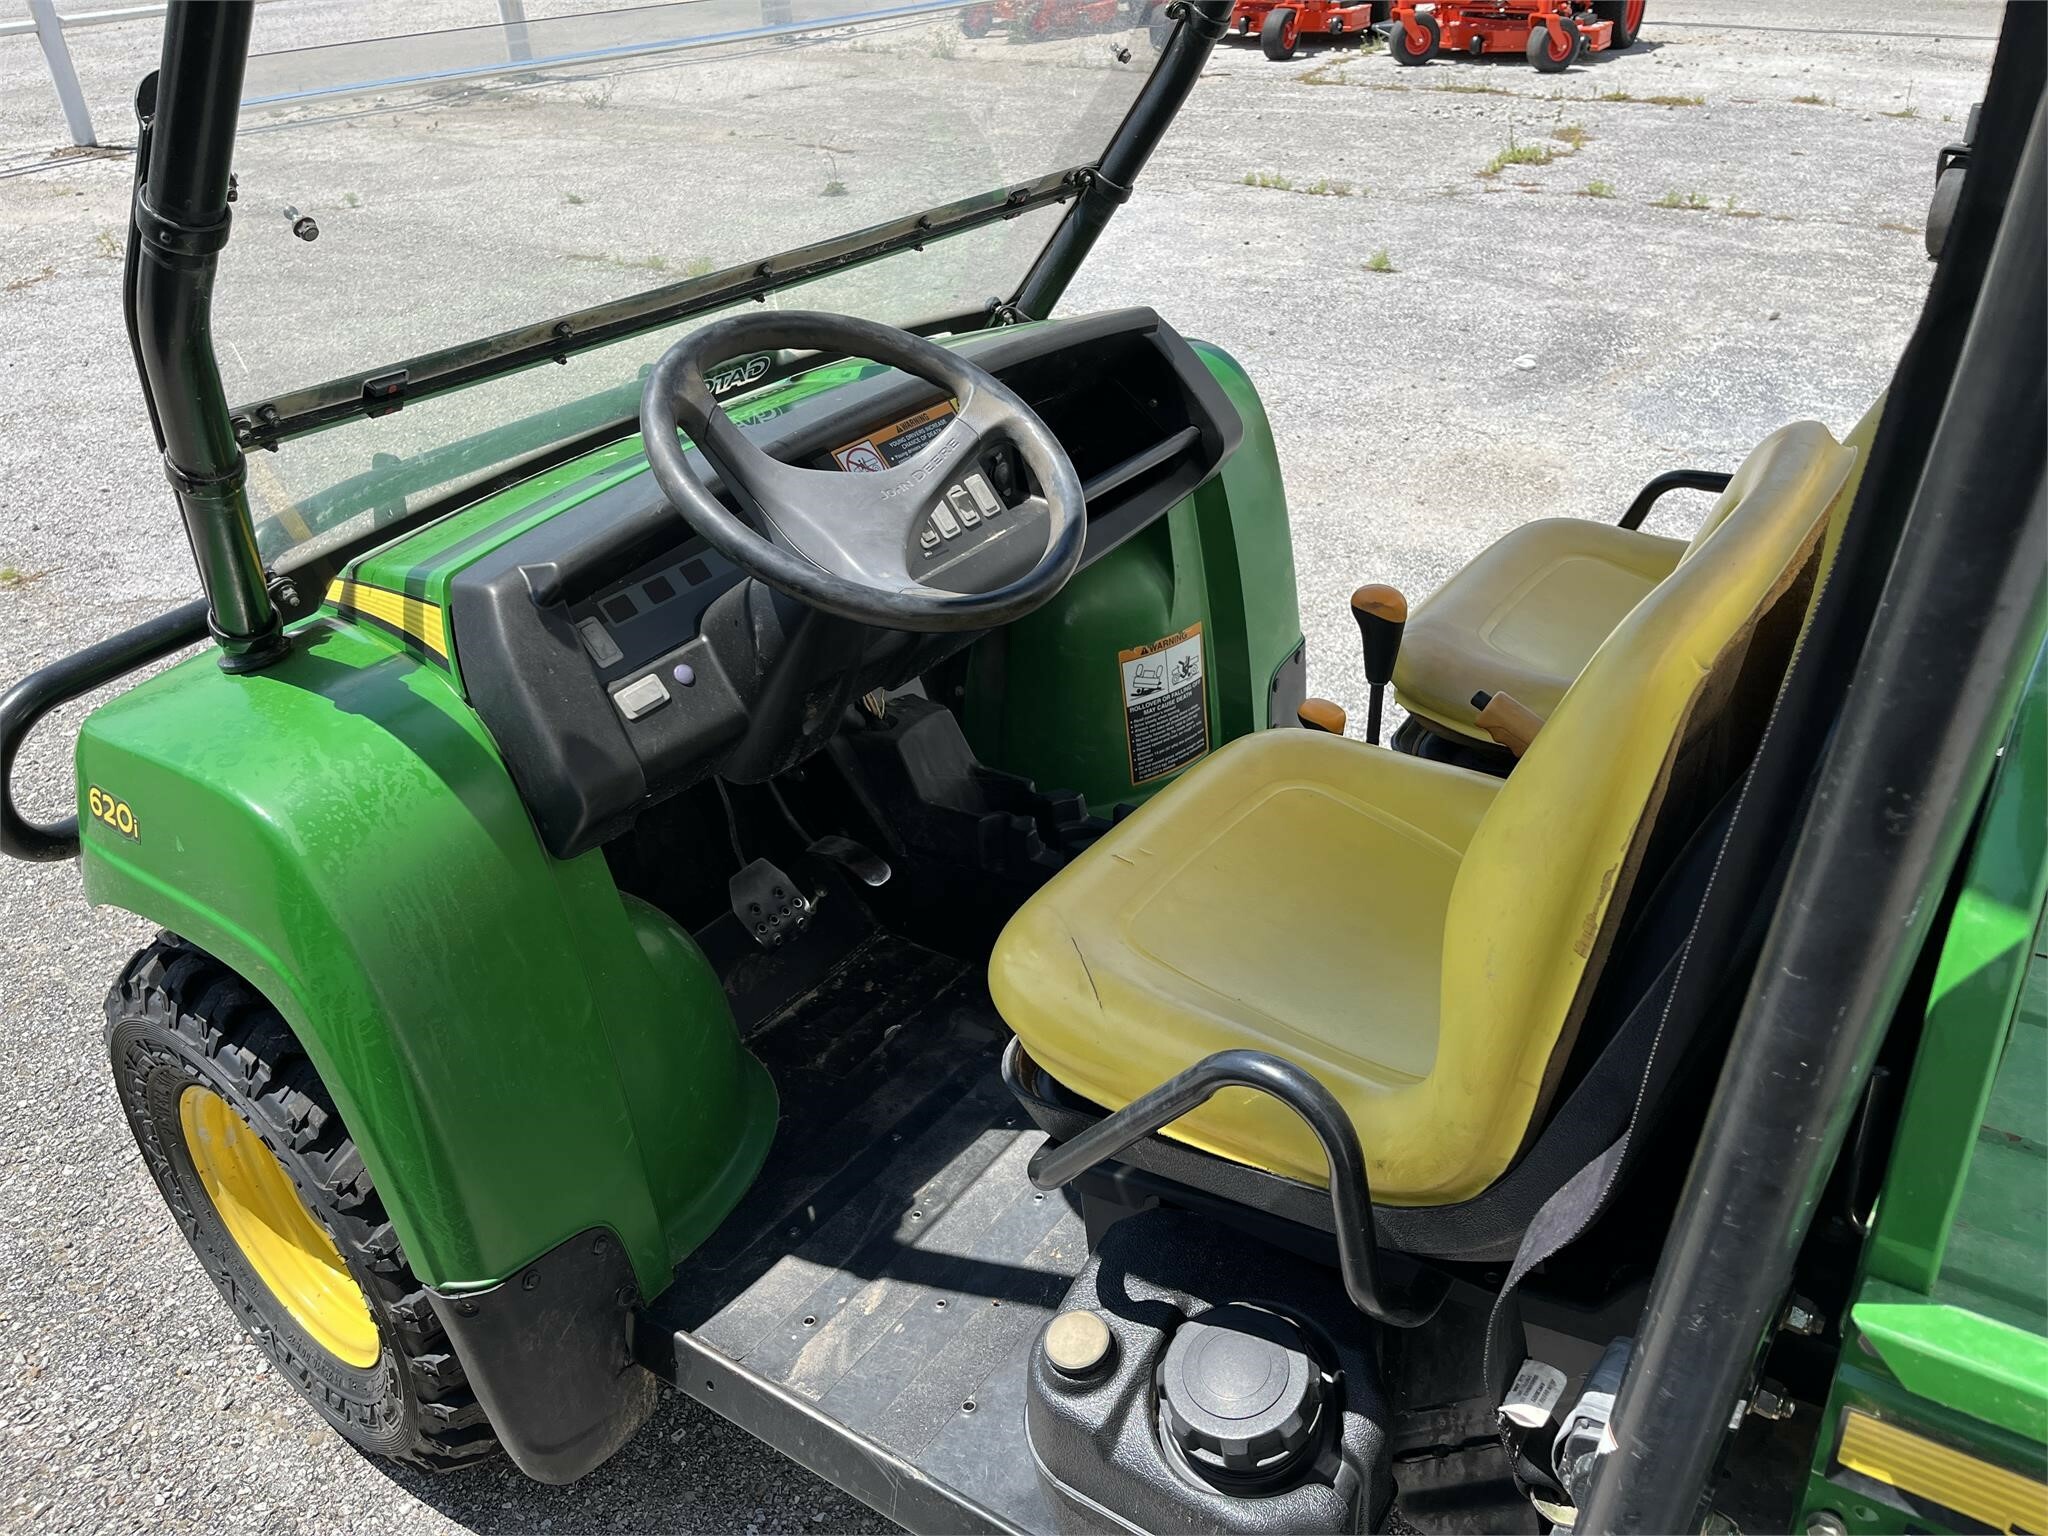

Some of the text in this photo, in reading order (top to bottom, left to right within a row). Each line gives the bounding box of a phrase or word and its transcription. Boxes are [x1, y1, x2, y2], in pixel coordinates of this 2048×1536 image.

[900, 413, 930, 431] WARNING
[880, 438, 960, 500] JOHN DEERE
[1149, 632, 1188, 652] WARNING
[1130, 698, 1162, 713] ROLLOVER
[1162, 694, 1171, 703] OR
[1171, 684, 1193, 698] FALLING
[1143, 691, 1193, 716] MAY CAUSE DEATH
[89, 787, 139, 839] 620i
